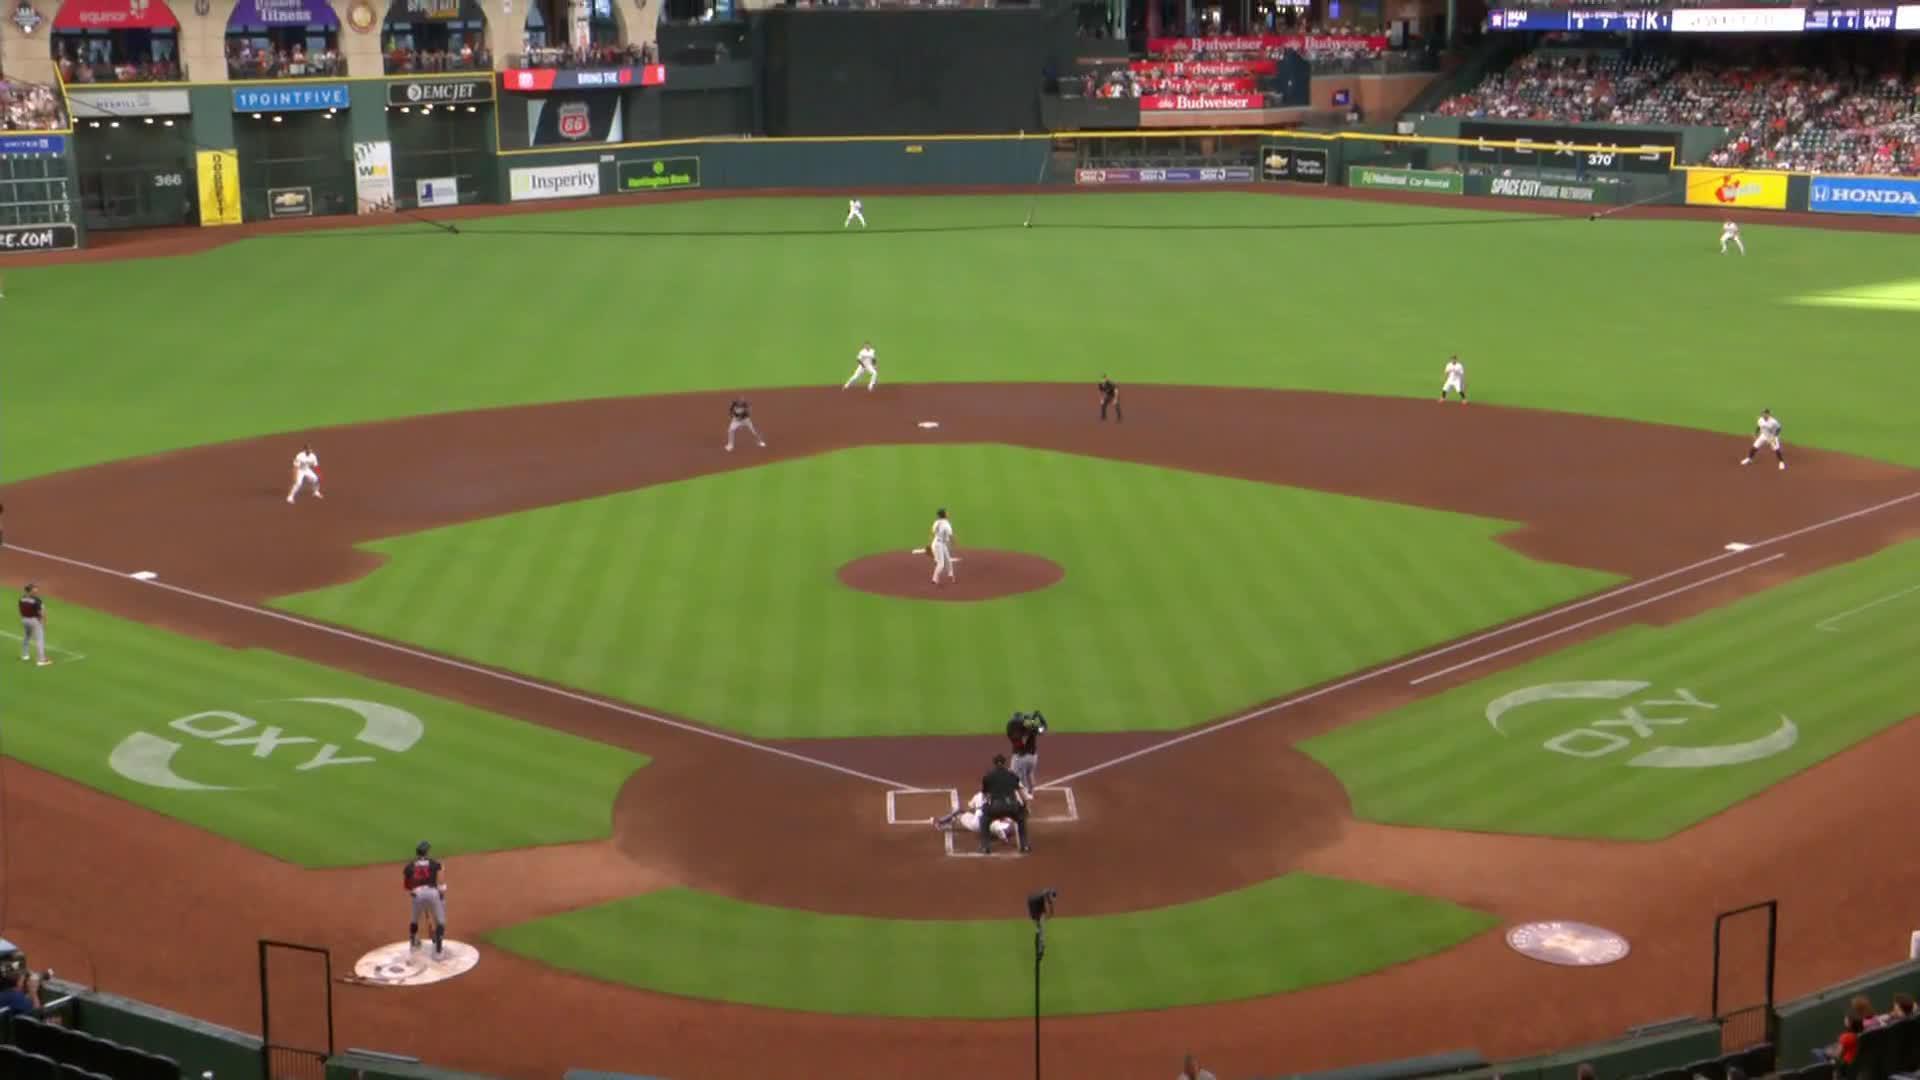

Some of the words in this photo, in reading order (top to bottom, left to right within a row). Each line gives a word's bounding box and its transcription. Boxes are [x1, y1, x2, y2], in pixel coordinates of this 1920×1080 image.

[1646, 11, 1658, 28] K
[1192, 38, 1263, 50] Budweiser
[240, 90, 342, 106] 1POINTFIVE
[423, 83, 476, 99] EMCJET
[1177, 95, 1248, 109] Budweiser
[564, 117, 584, 132] 66
[1588, 153, 1612, 166] 370
[358, 165, 389, 177] WM
[154, 174, 182, 187] 366
[531, 170, 596, 191] Insperity
[1491, 178, 1521, 195] SPACE
[1521, 180, 1543, 196] CITY
[1832, 188, 1917, 204] HONDA
[1543, 688, 1718, 757] OXY
[168, 711, 376, 770] OXY
